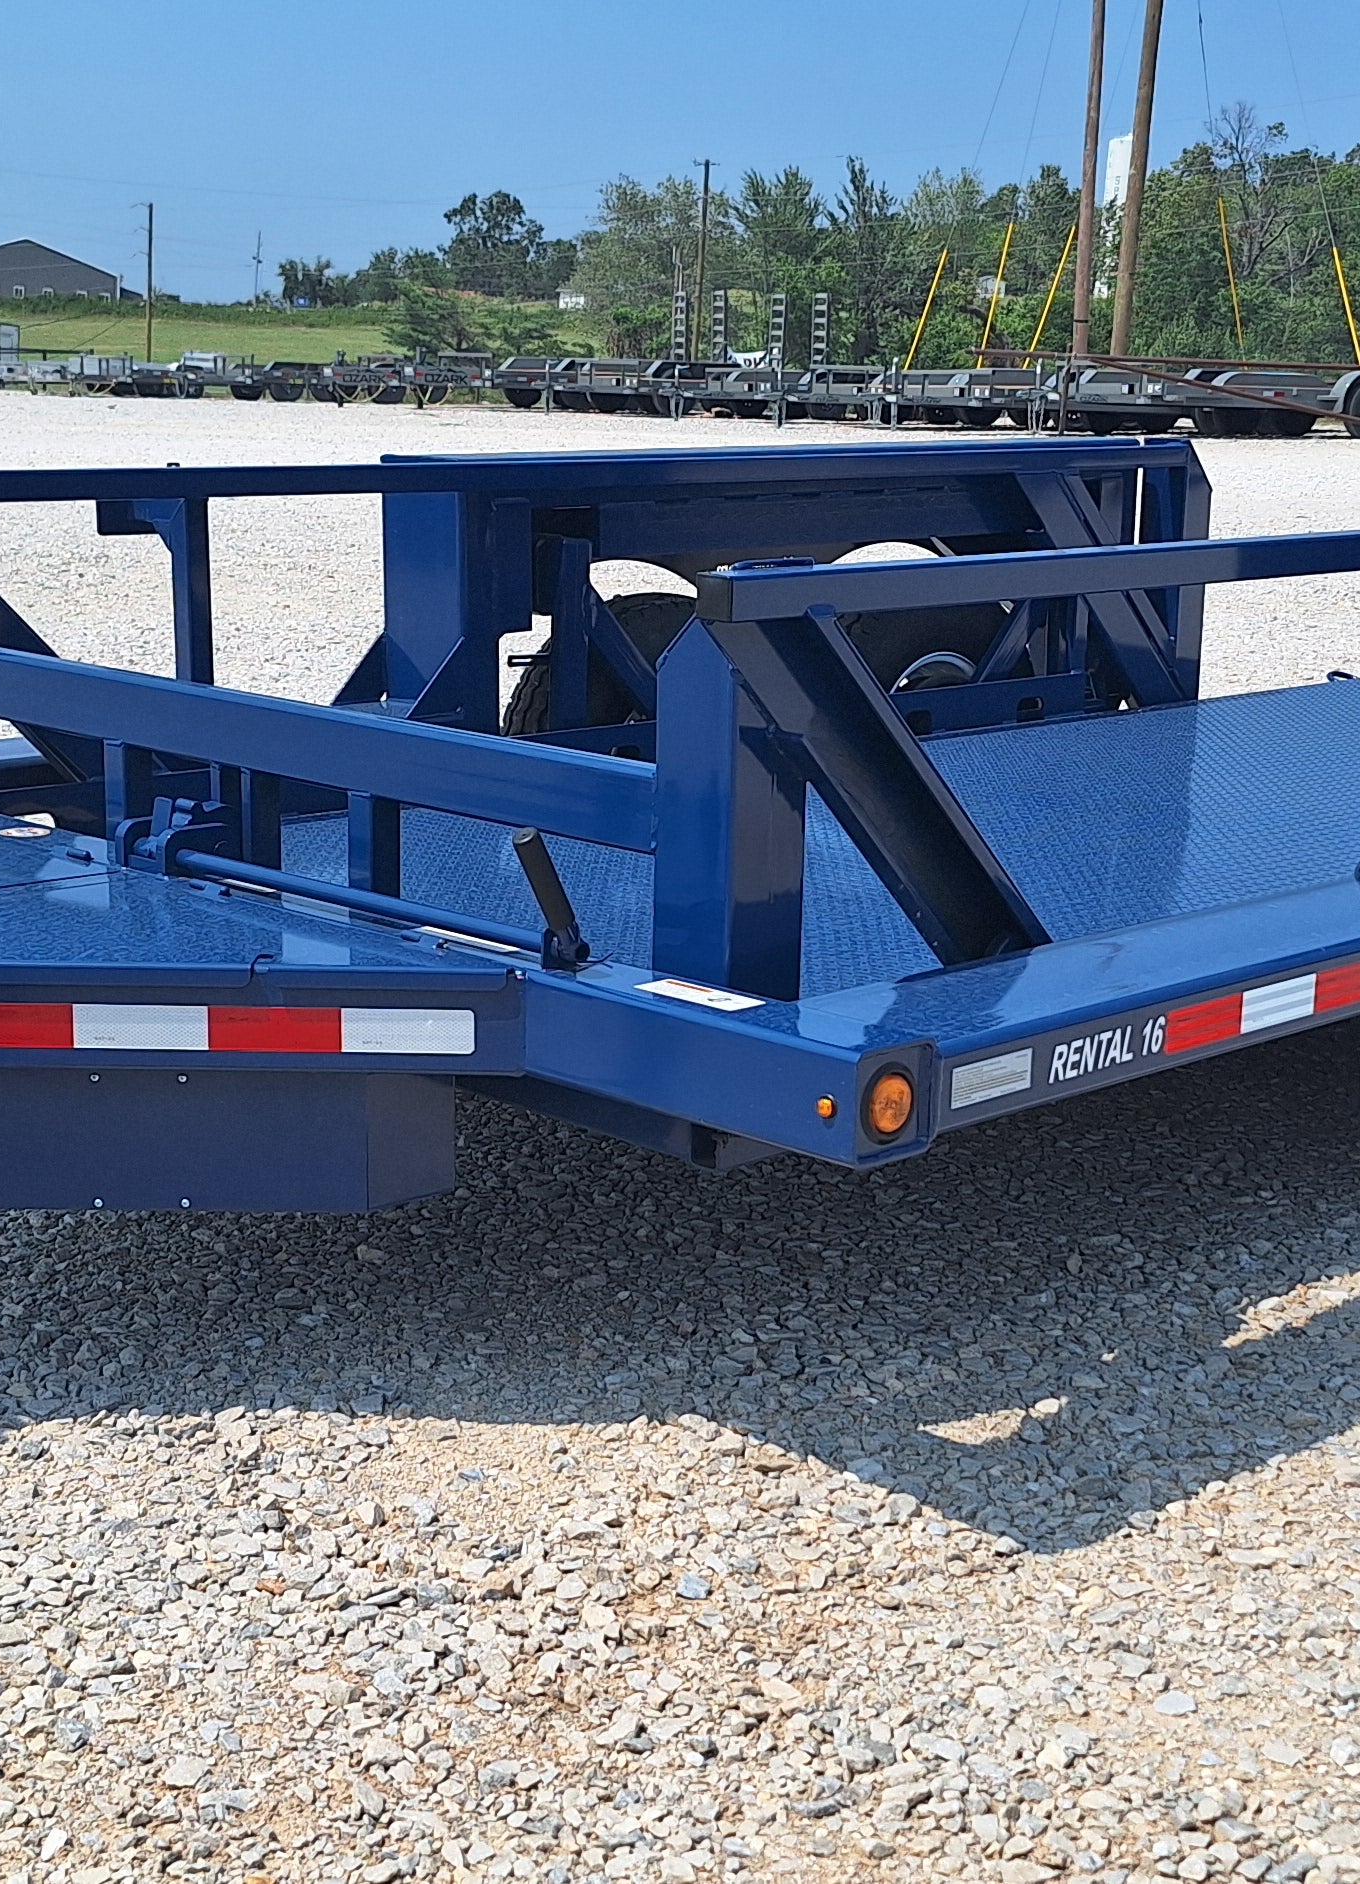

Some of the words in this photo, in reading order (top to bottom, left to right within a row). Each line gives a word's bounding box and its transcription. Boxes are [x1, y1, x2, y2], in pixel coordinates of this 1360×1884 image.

[342, 373, 386, 384] OZARK
[424, 373, 468, 385] OZARK
[1048, 1025, 1134, 1084] RENTAL
[1141, 1015, 1166, 1056] 16
